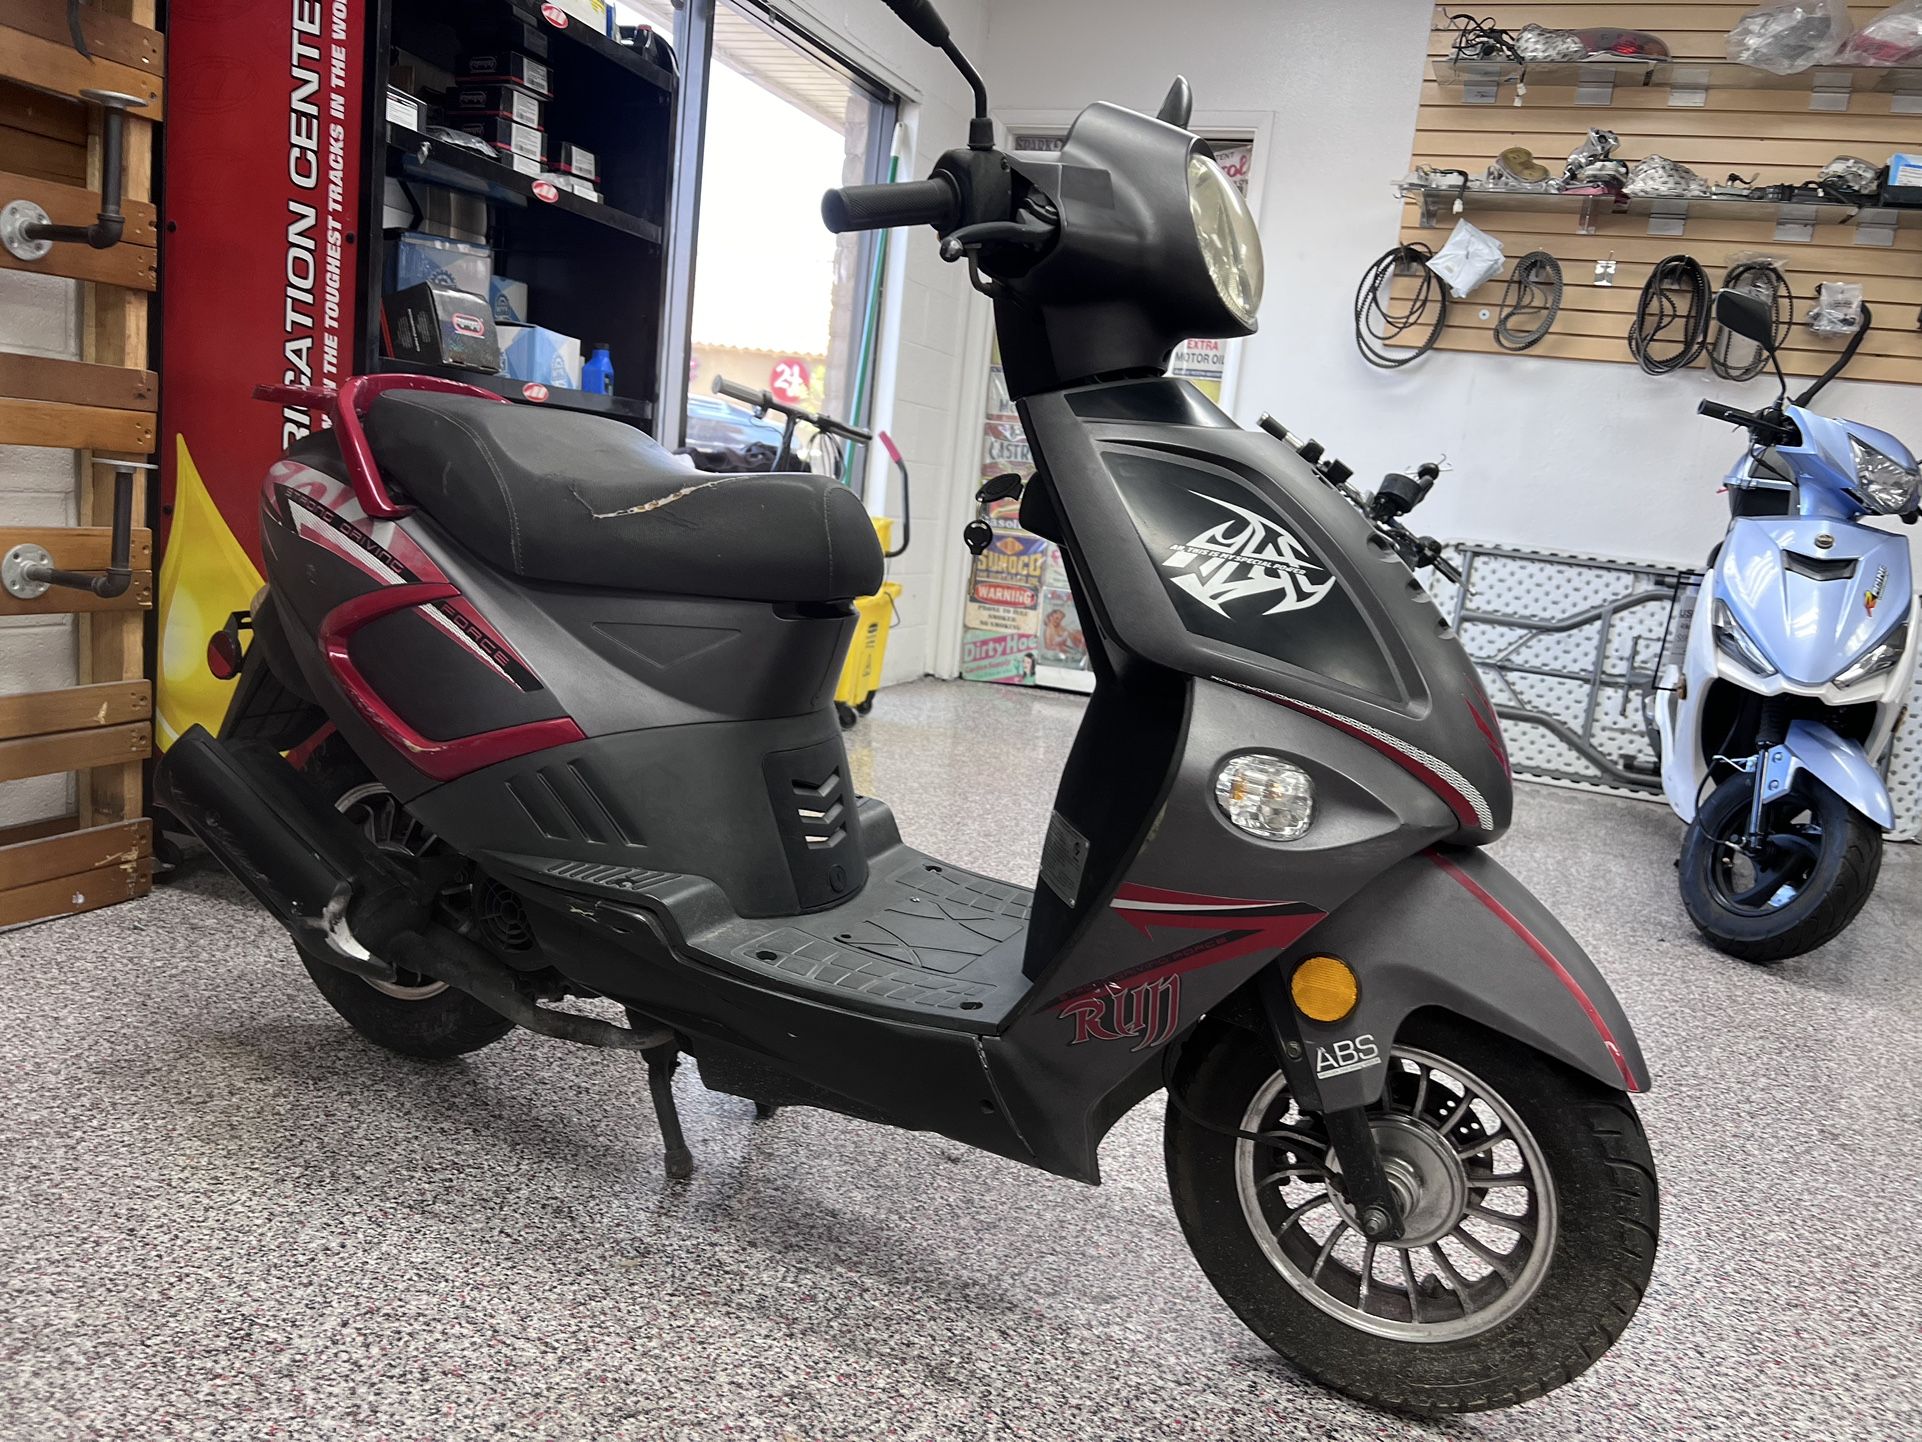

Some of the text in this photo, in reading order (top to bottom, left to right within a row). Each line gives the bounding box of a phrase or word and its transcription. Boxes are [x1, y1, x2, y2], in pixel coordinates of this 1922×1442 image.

[331, 44, 347, 88] THE
[289, 0, 322, 188] CENTE
[330, 93, 346, 119] IN
[328, 123, 345, 212] TRACKS
[325, 216, 343, 329] TOUGHEST
[323, 333, 339, 375] THE
[1175, 352, 1225, 365] MOTOR OIL
[1187, 339, 1219, 351] EXTRA
[284, 487, 405, 573] STRONG DRIVING
[977, 551, 1043, 577] SUNOCO
[1187, 547, 1209, 555] THIS
[1219, 553, 1236, 561] MY
[1234, 555, 1272, 568] SPECIAL
[978, 585, 1033, 606] WARNING
[440, 603, 510, 667] FORCE
[963, 640, 1006, 662] Dirty
[1316, 1034, 1379, 1072] ABS
